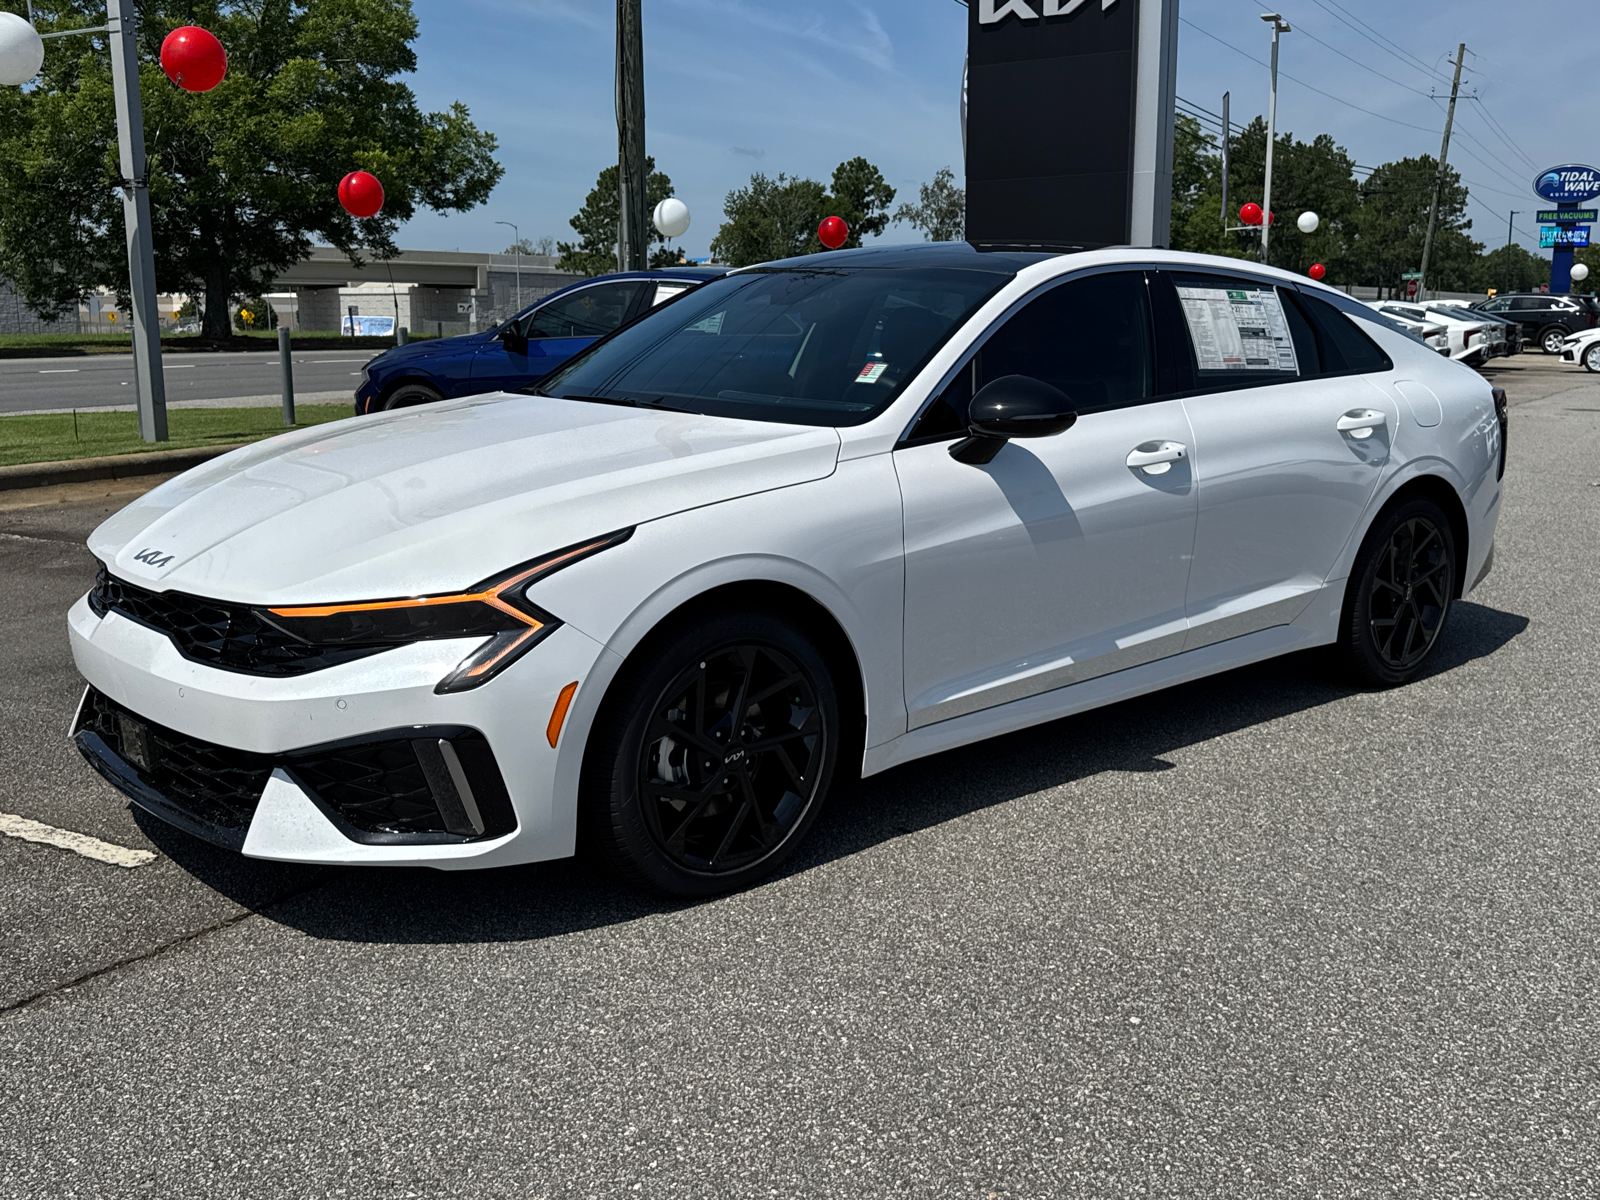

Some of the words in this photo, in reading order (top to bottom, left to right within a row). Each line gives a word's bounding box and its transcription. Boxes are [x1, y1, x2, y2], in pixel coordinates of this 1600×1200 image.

[979, 0, 1117, 24] KI
[1560, 171, 1594, 182] TIDAL
[1564, 181, 1600, 192] WAVE
[1538, 212, 1558, 220] FREE
[1559, 211, 1595, 219] VACUUMS
[133, 547, 176, 569] KIA
